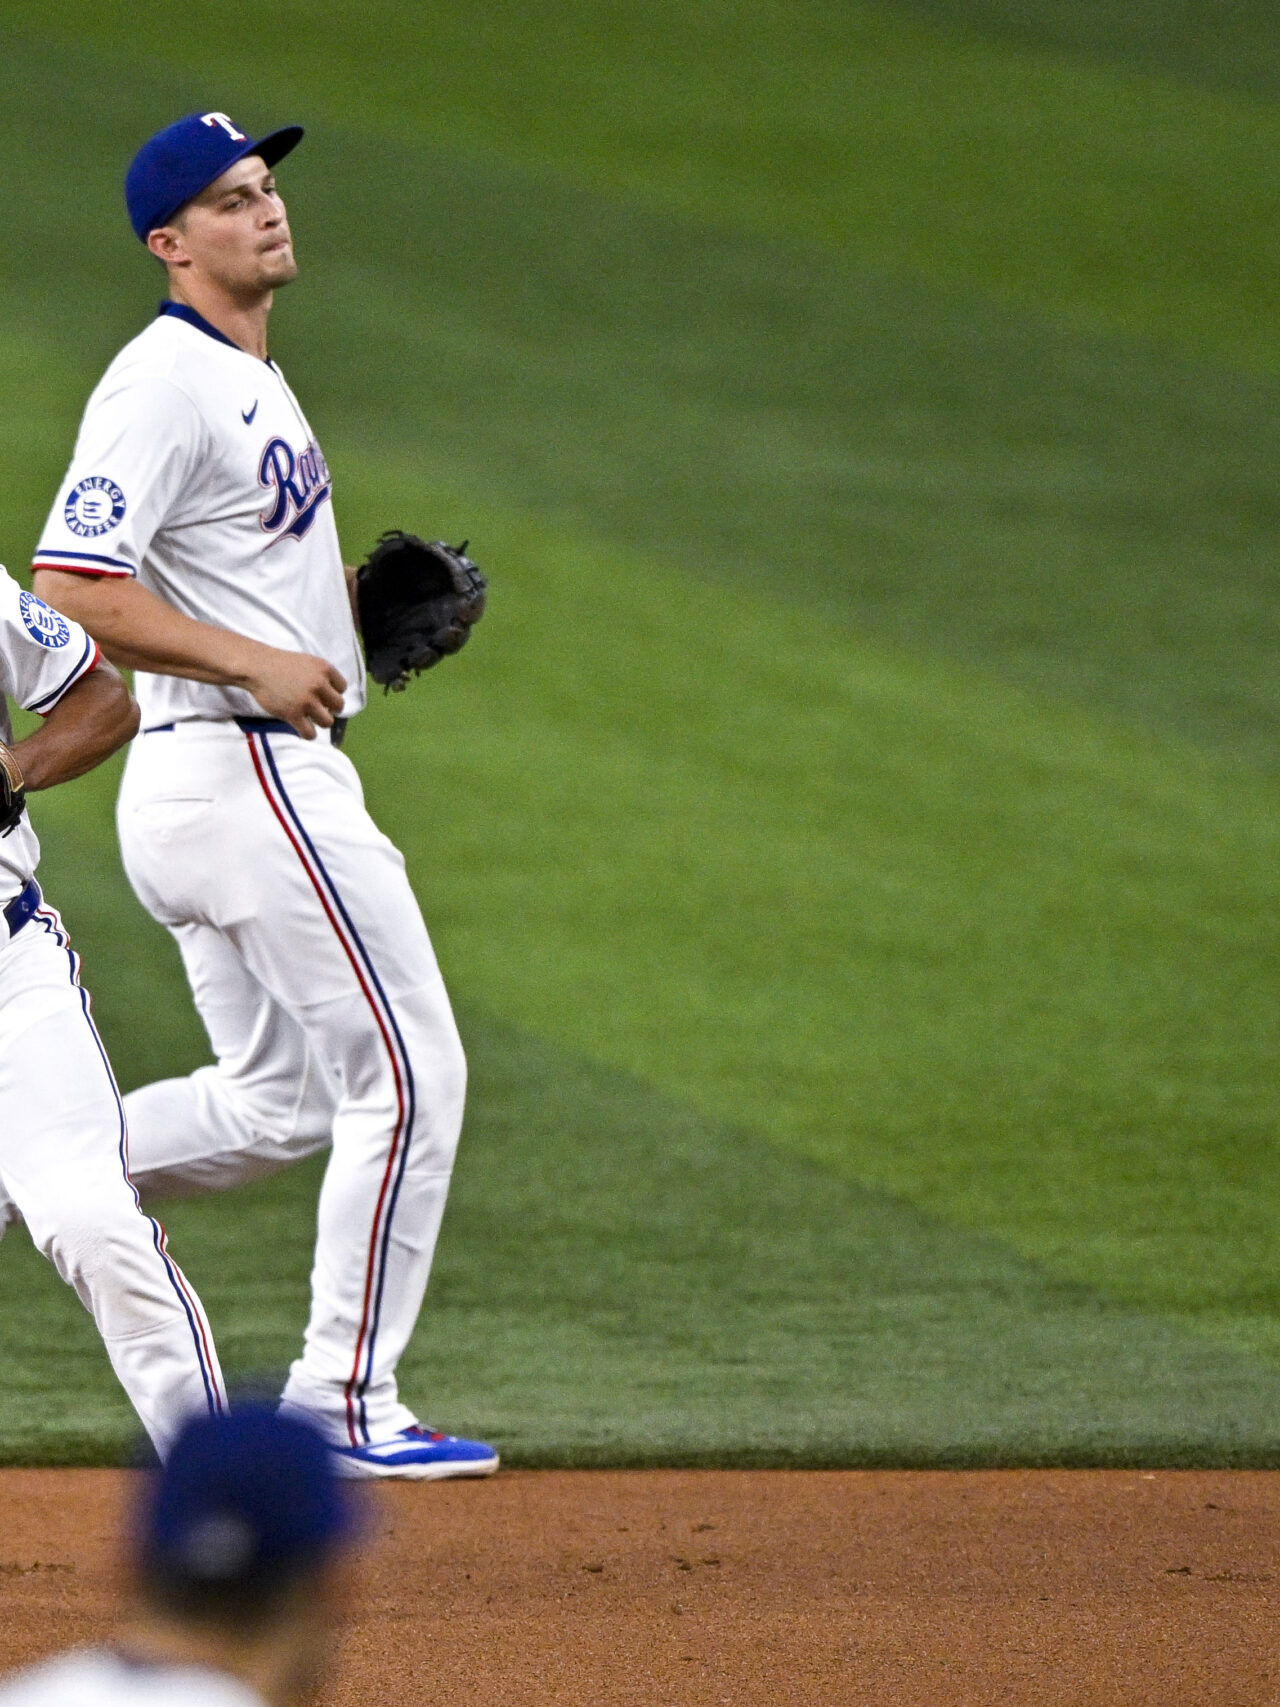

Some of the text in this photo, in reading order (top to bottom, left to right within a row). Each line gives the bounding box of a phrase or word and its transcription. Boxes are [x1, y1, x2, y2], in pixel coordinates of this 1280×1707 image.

[201, 112, 247, 141] T
[73, 477, 125, 508] ENERGY
[66, 504, 121, 537] TRANSFER
